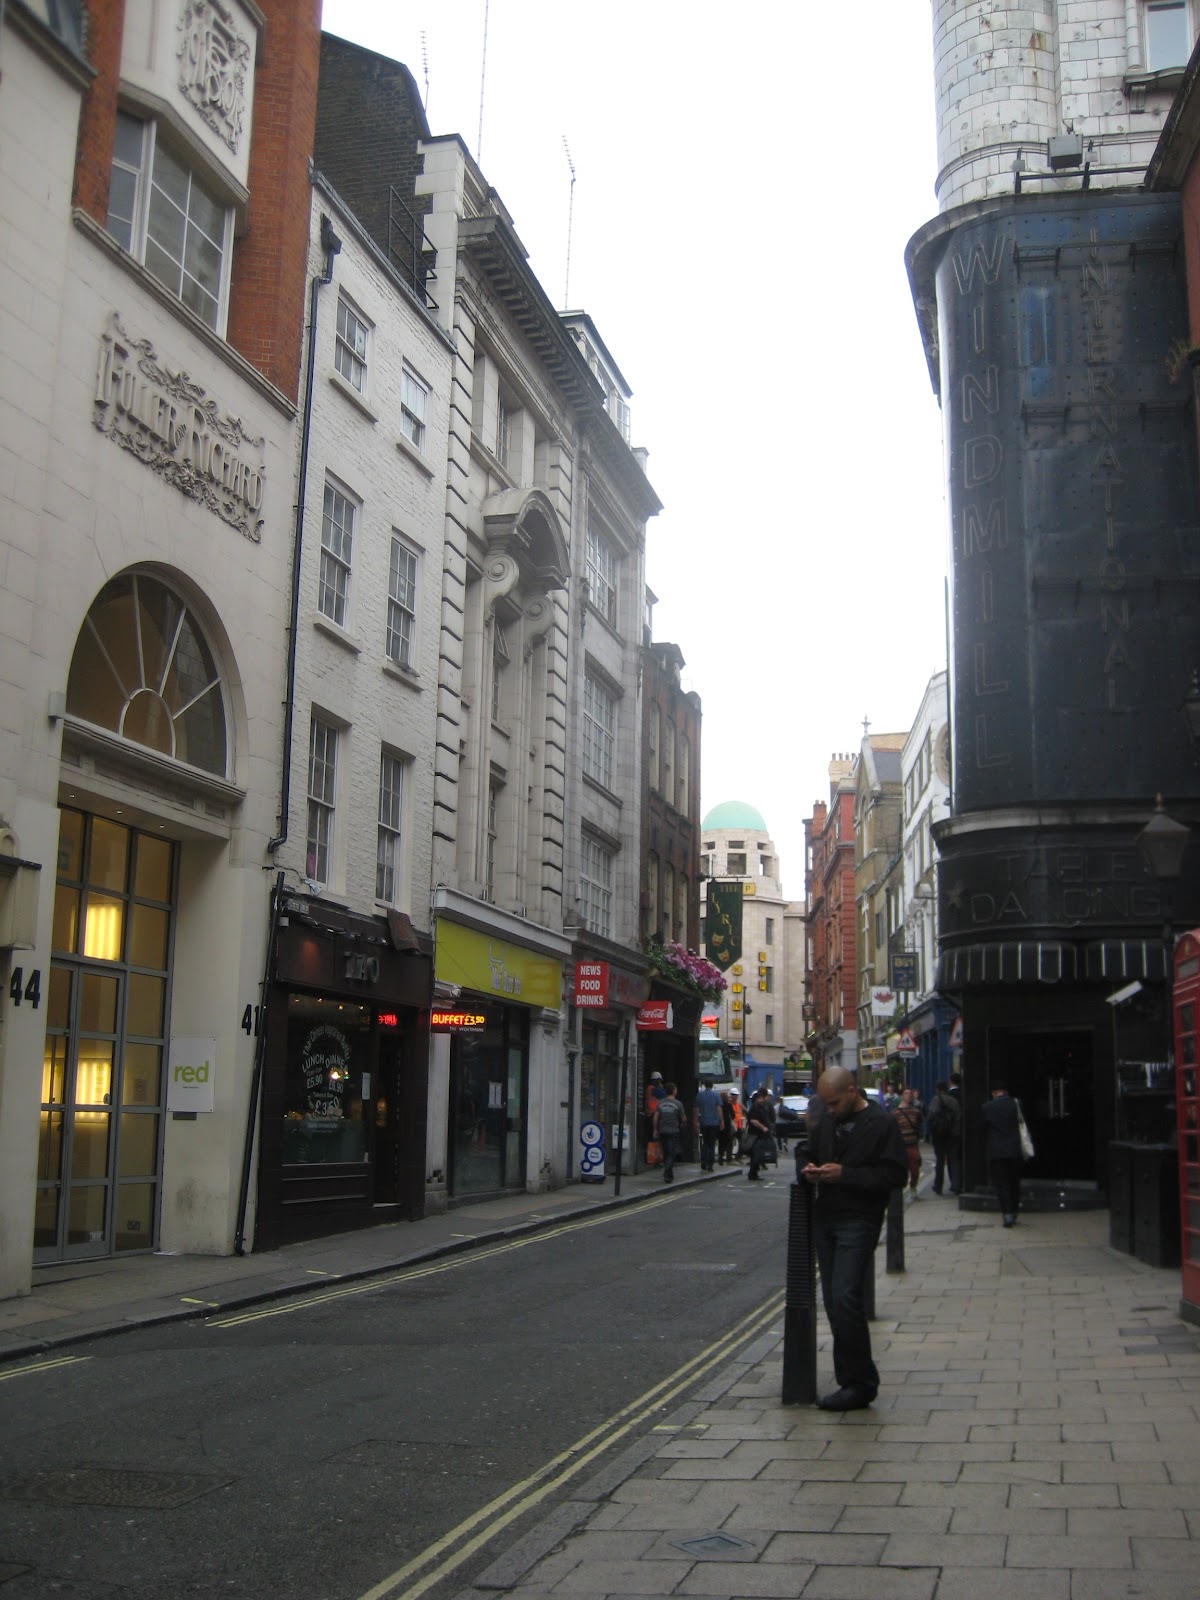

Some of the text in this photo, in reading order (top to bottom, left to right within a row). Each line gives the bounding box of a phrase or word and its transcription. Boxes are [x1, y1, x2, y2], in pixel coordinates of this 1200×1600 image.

[94, 334, 178, 452] FULLER
[184, 404, 264, 511] RICHARD
[1080, 227, 1136, 712] INTERNATIONAL
[952, 234, 1012, 769] WINDMILL
[998, 850, 1138, 883] TABLE
[719, 883, 739, 893] THE
[710, 892, 738, 948] LYRIC
[580, 965, 601, 976] NEWS
[9, 966, 41, 1009] 44
[580, 980, 600, 991] FOOD
[576, 994, 604, 1006] DRINKS
[241, 1003, 260, 1037] 41
[432, 1012, 486, 1026] BUFFET £3.50
[174, 1060, 210, 1083] red
[302, 1054, 325, 1073] LUNCH
[315, 1096, 340, 1116] £350
